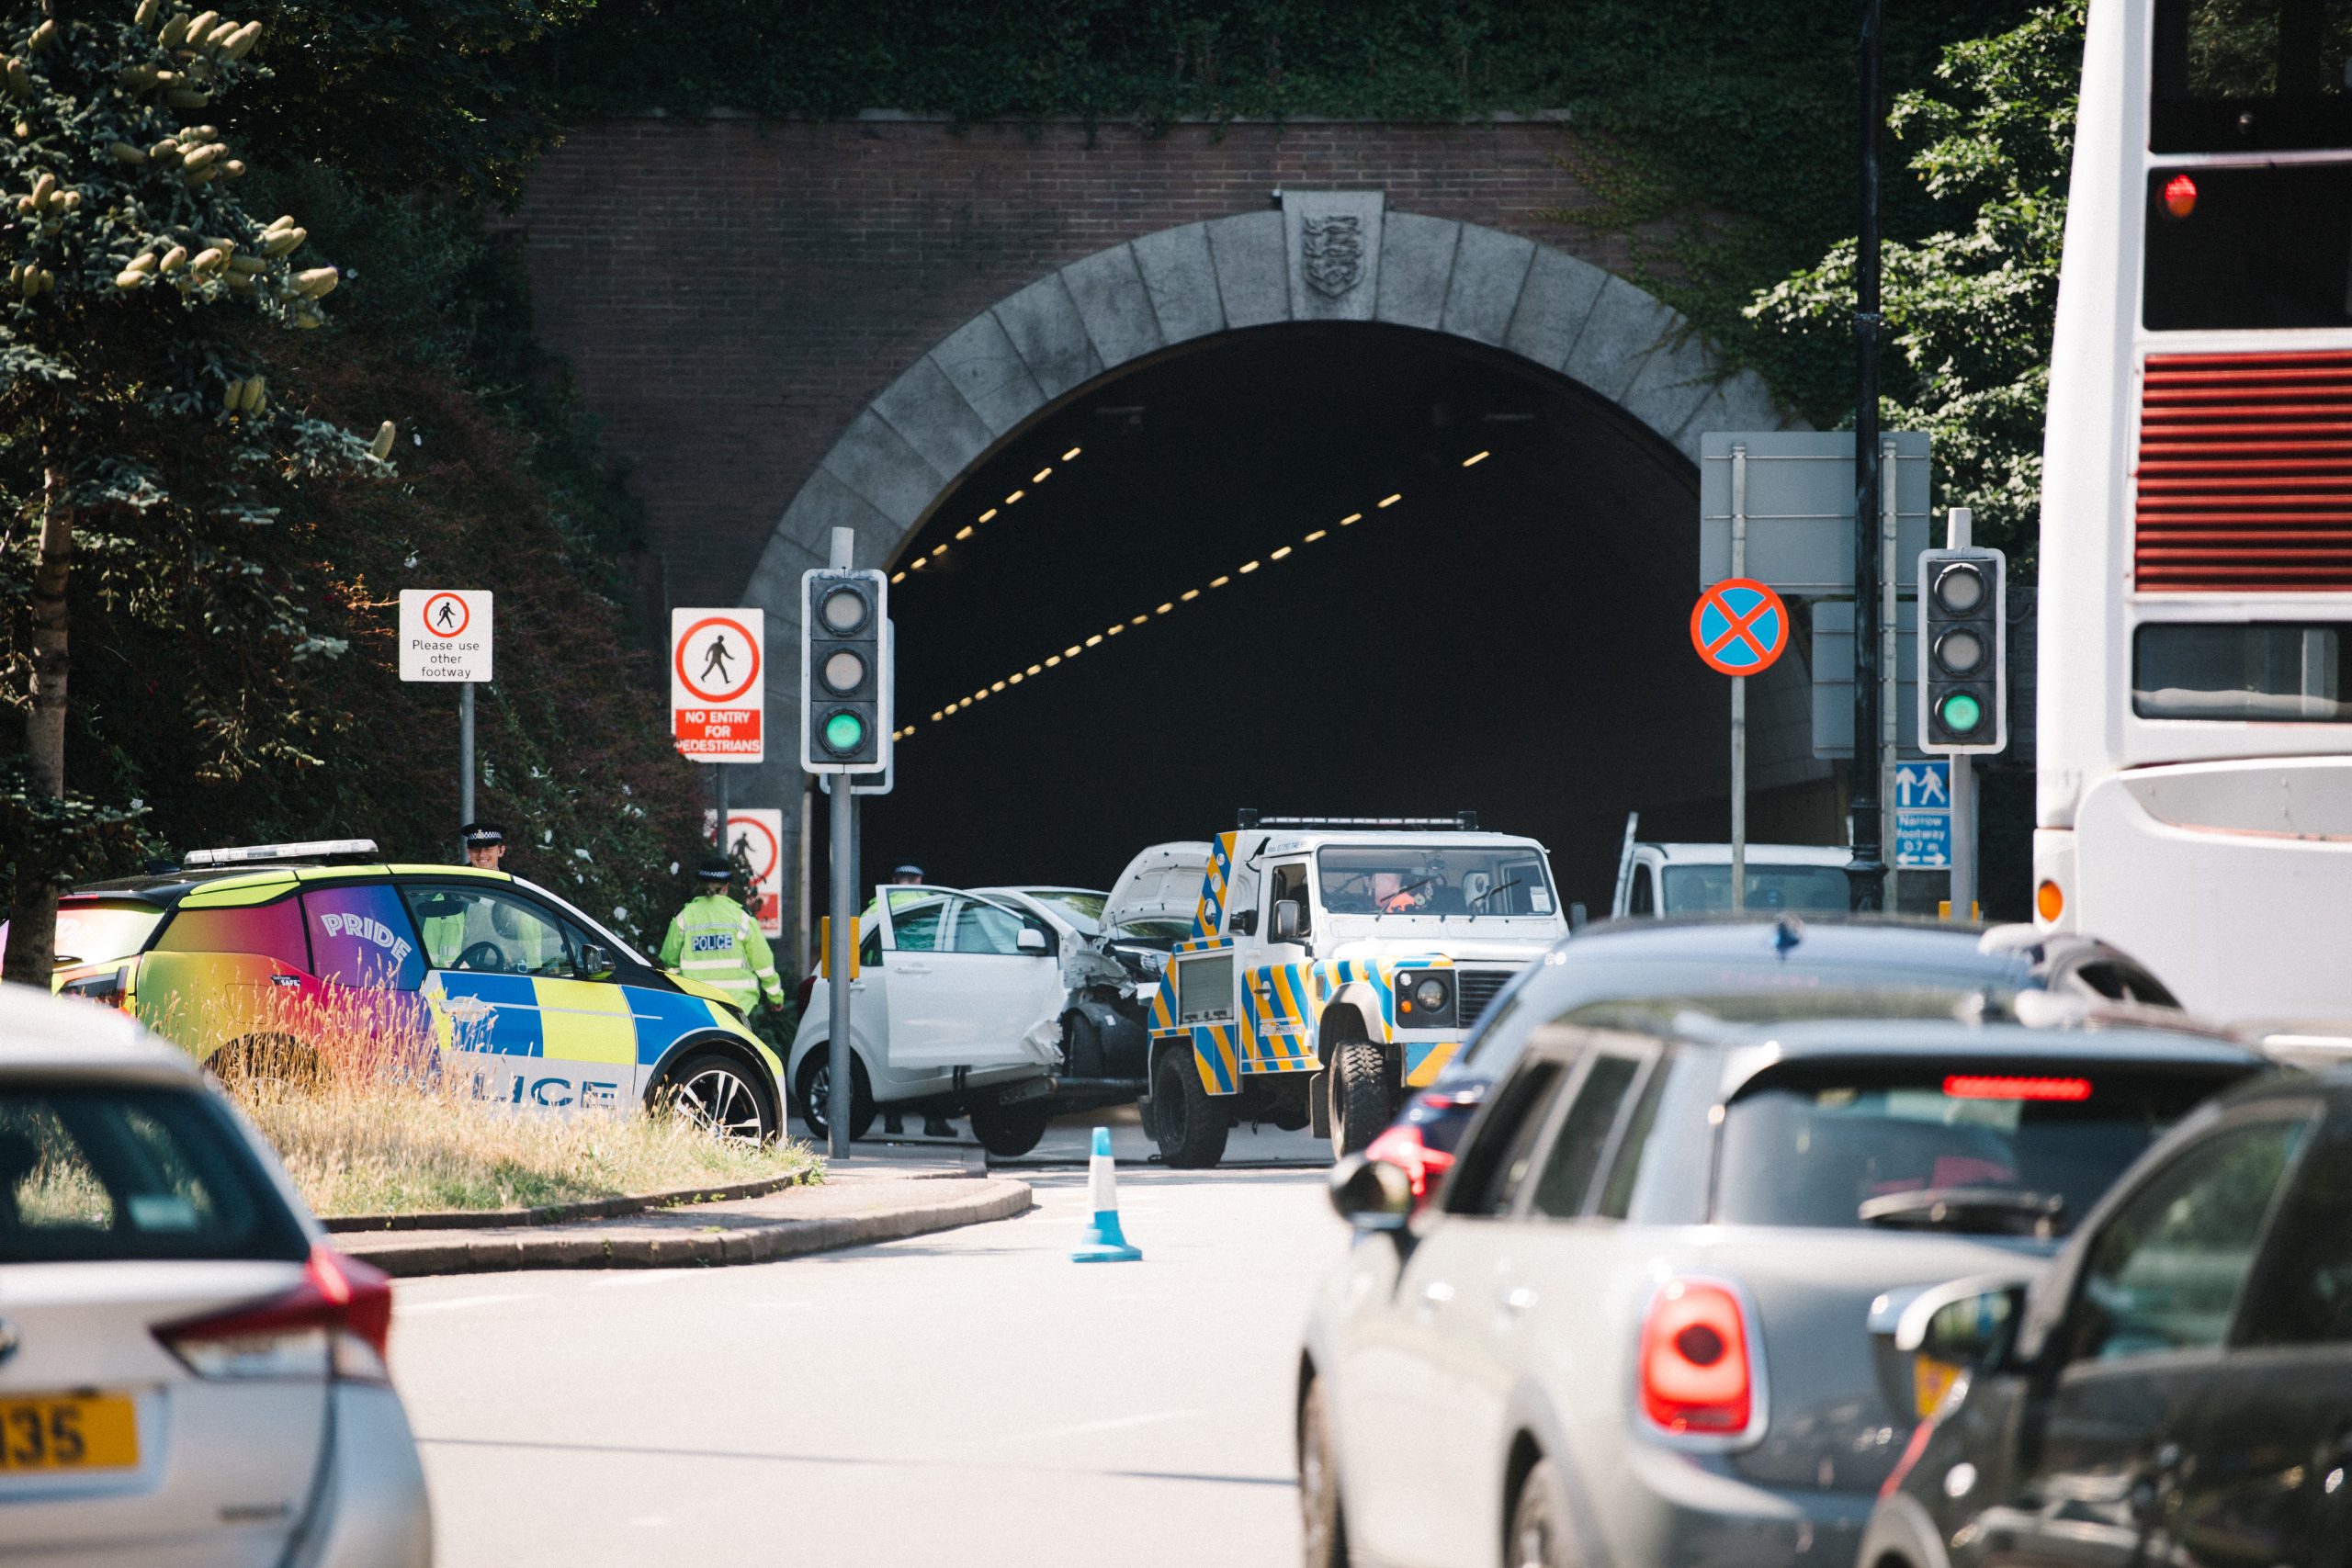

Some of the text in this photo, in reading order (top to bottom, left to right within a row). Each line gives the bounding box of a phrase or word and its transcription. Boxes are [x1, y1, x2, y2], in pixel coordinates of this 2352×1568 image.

[413, 639, 480, 650] Please use
[430, 653, 462, 663] other
[422, 666, 471, 680] footway
[684, 711, 751, 724] NO ENTRY
[705, 725, 731, 738] FOR
[321, 913, 412, 962] PRIDE
[694, 935, 732, 950] POLICE
